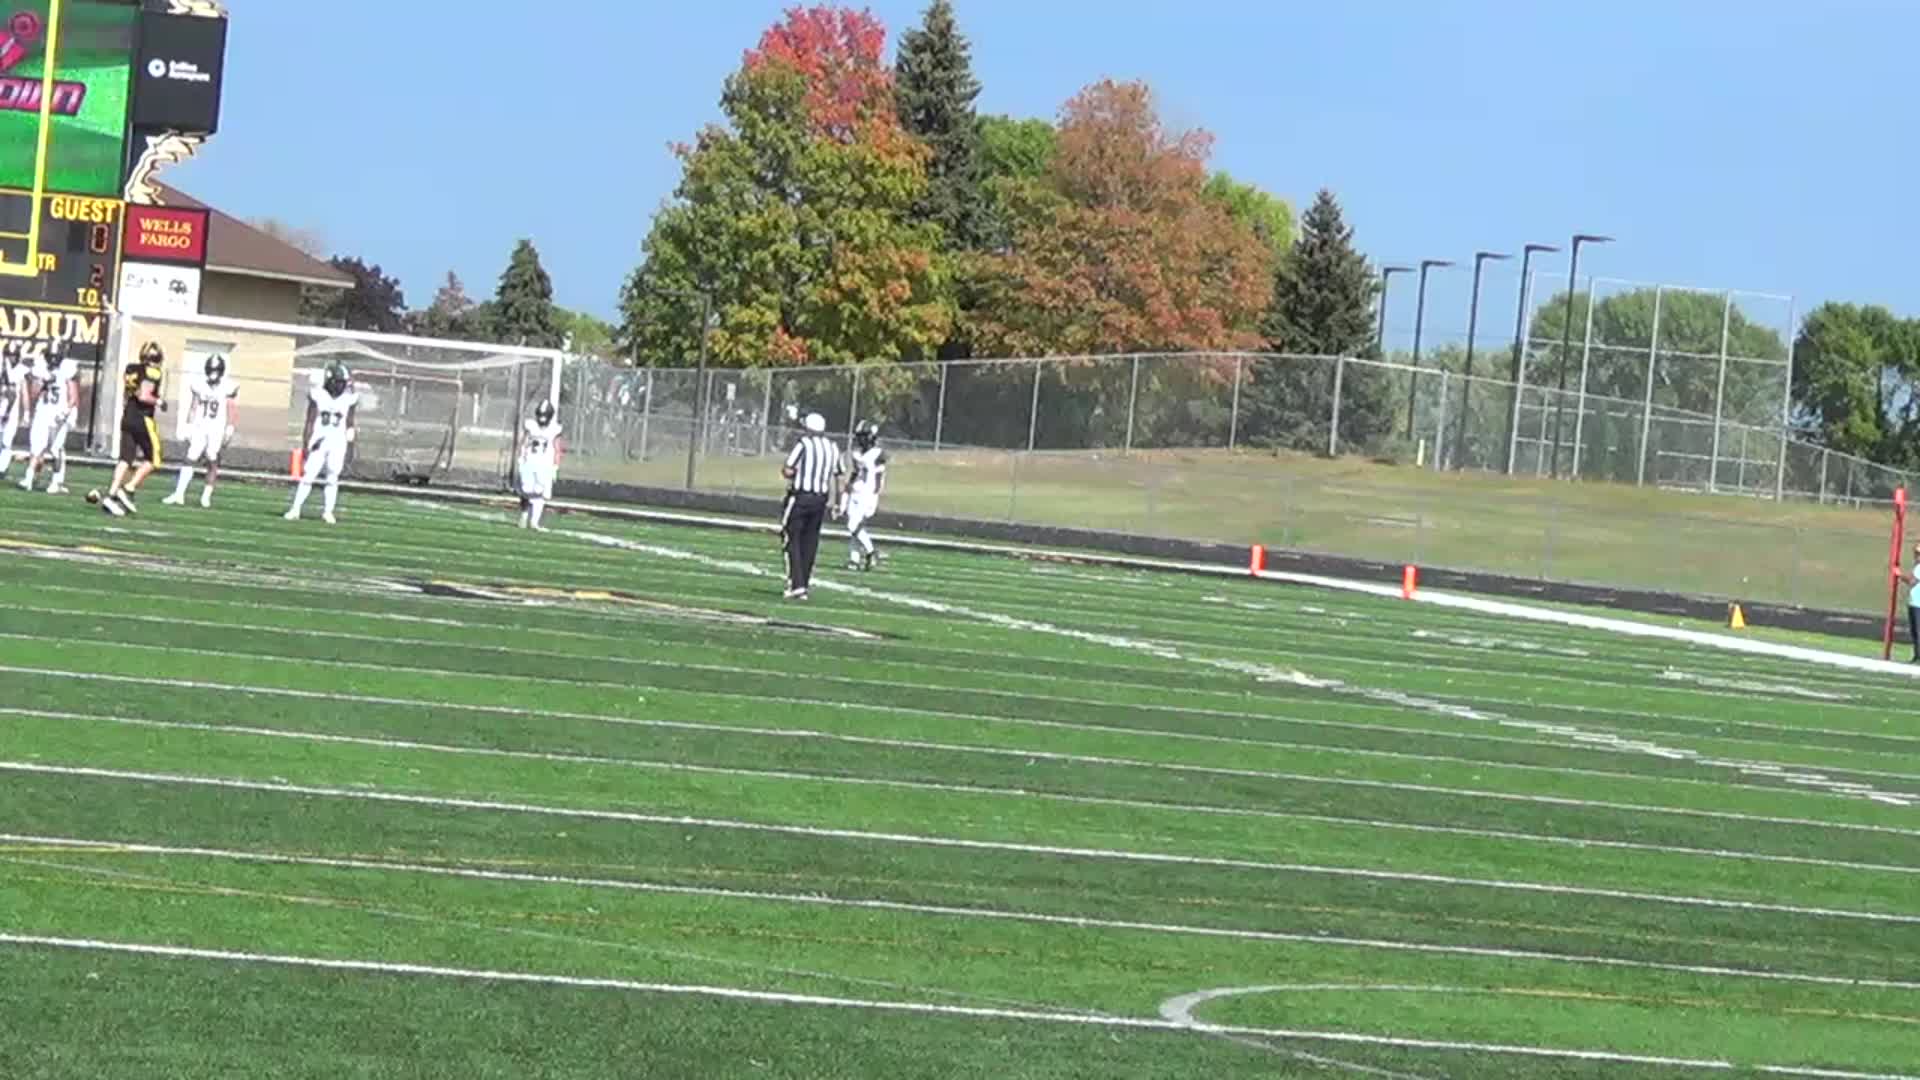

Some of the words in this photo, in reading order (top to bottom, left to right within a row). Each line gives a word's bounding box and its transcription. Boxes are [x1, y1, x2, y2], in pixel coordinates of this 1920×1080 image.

[50, 197, 118, 223] GUEST
[139, 217, 192, 234] WELLS
[140, 232, 192, 249] FARGO
[38, 252, 56, 271] TR
